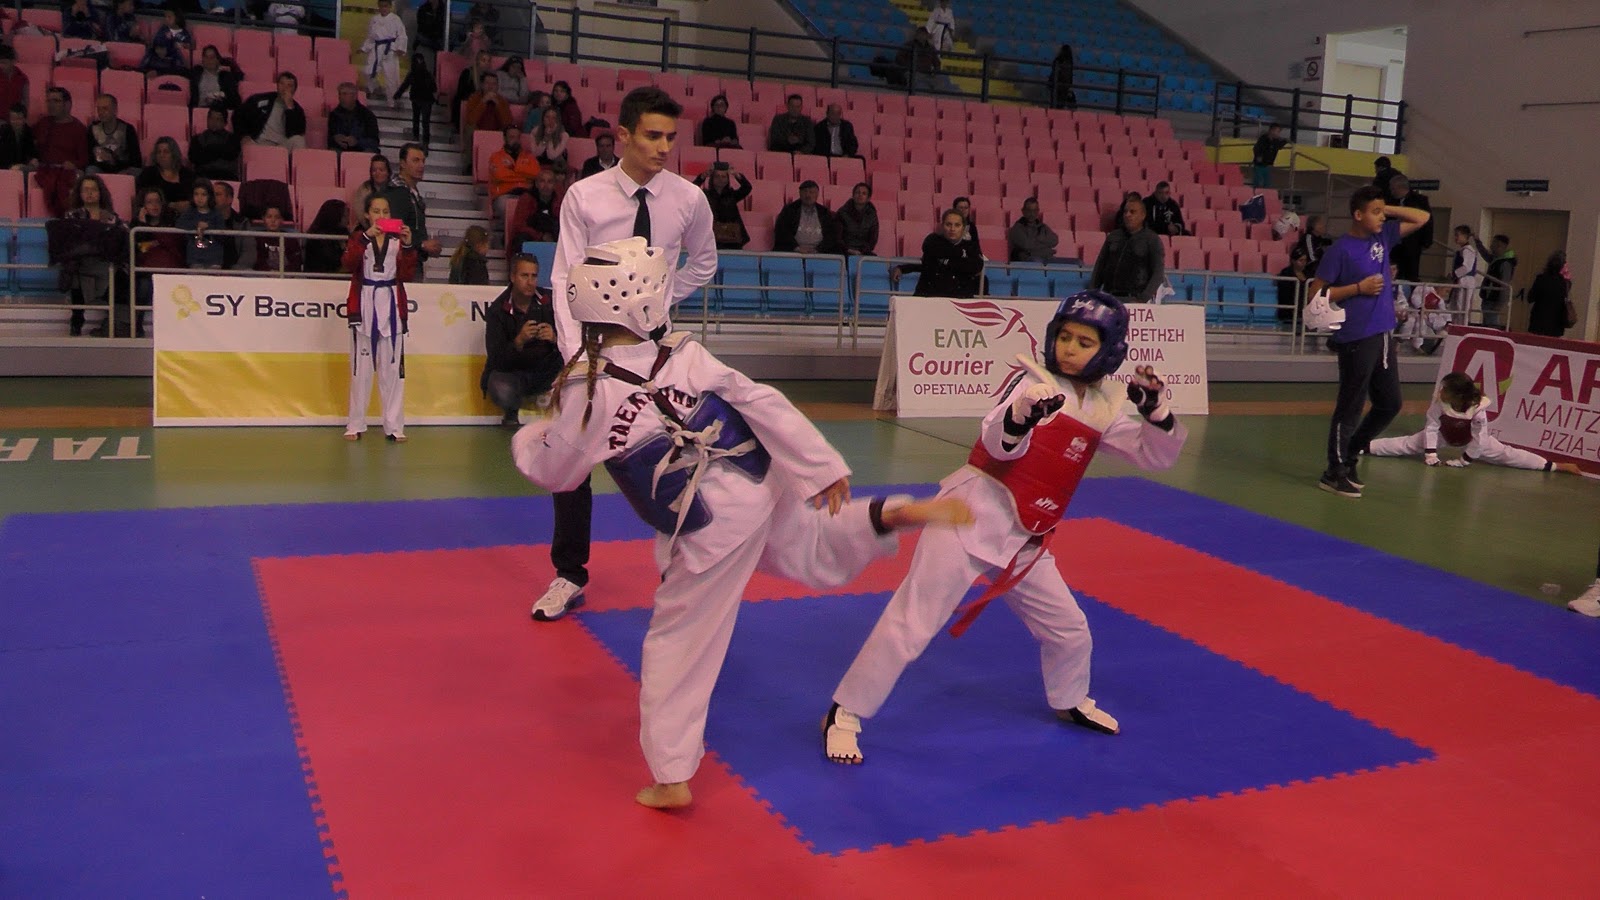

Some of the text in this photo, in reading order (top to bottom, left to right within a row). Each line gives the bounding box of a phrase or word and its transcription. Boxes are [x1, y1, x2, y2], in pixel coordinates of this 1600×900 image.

[205, 294, 245, 316] SY
[934, 329, 988, 349] ΕΛΤΑ
[908, 352, 994, 375] Courier
[913, 383, 991, 395] ΟΡΕΣΤΙΑΔΑΣ
[1184, 374, 1200, 385] 200
